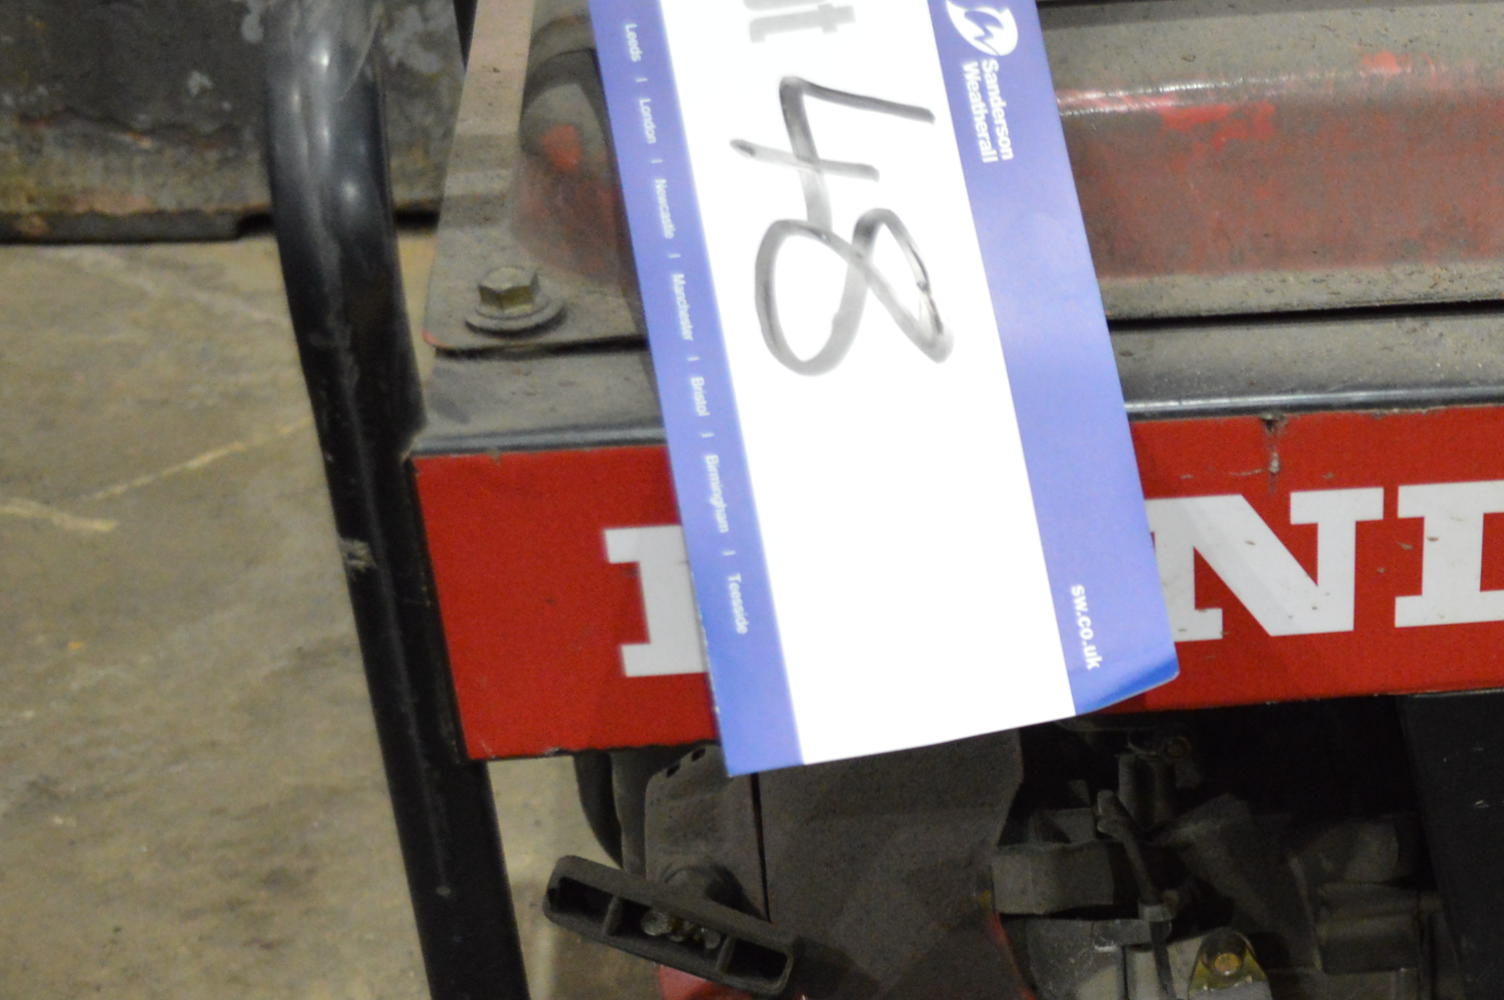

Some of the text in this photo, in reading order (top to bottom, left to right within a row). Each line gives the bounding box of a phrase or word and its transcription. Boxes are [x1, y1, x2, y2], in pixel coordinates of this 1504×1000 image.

[962, 60, 999, 164] Weatherall
[981, 58, 1014, 161] Sanderson
[729, 75, 953, 376] 48
[624, 22, 750, 635] Leeds London Newcastle Manchester Bristol Birmingham Teesside
[1070, 584, 1103, 671] sw.co.uk
